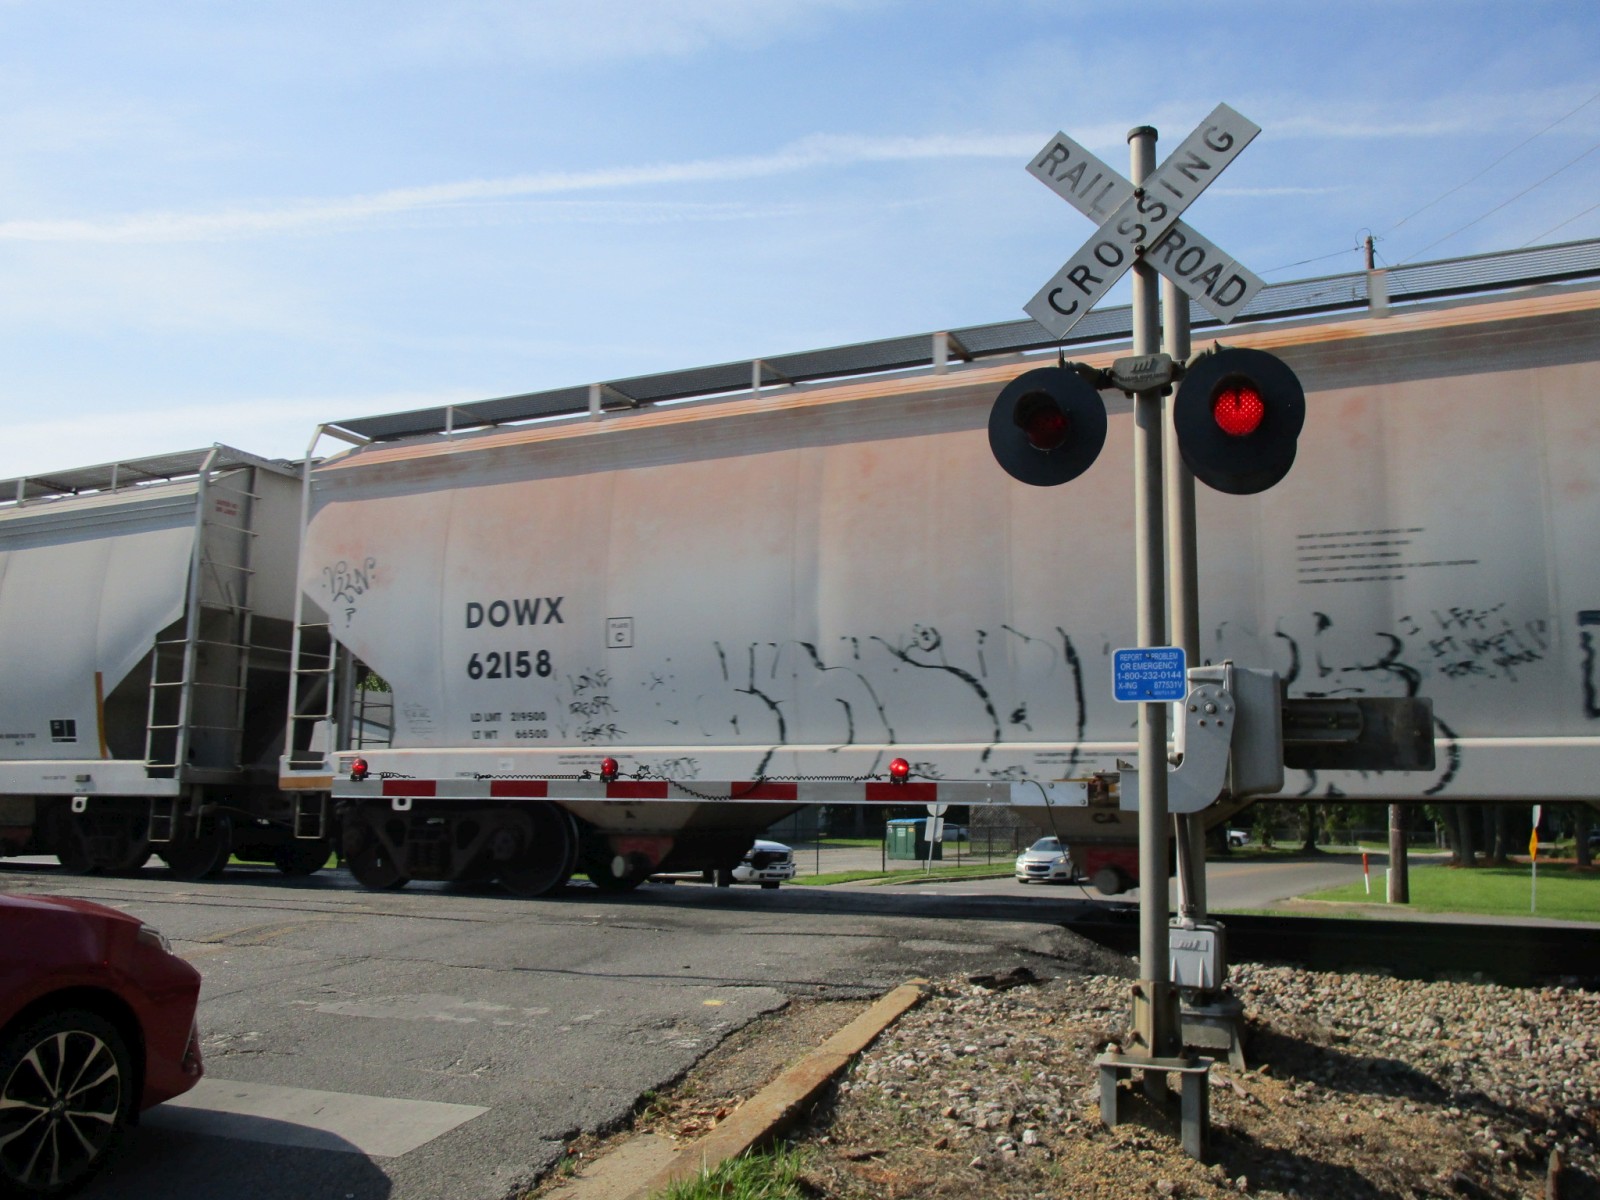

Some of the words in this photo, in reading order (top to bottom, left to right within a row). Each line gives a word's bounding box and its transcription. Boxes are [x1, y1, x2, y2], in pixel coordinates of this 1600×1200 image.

[1037, 142, 1115, 218] RAIL
[1151, 228, 1248, 308] ROAD
[1047, 125, 1234, 316] CROSSING
[466, 596, 565, 629] DOWX
[615, 632, 625, 642] C
[1120, 653, 1143, 661] REPORT
[1151, 652, 1178, 660] PROBLEM
[467, 649, 552, 680] 62158
[1120, 663, 1131, 671] OR
[1133, 661, 1178, 670] EMERGENCY
[1117, 671, 1181, 680] 1-800-232-0144
[1118, 682, 1138, 690] X-ING
[514, 730, 549, 739] 66500
